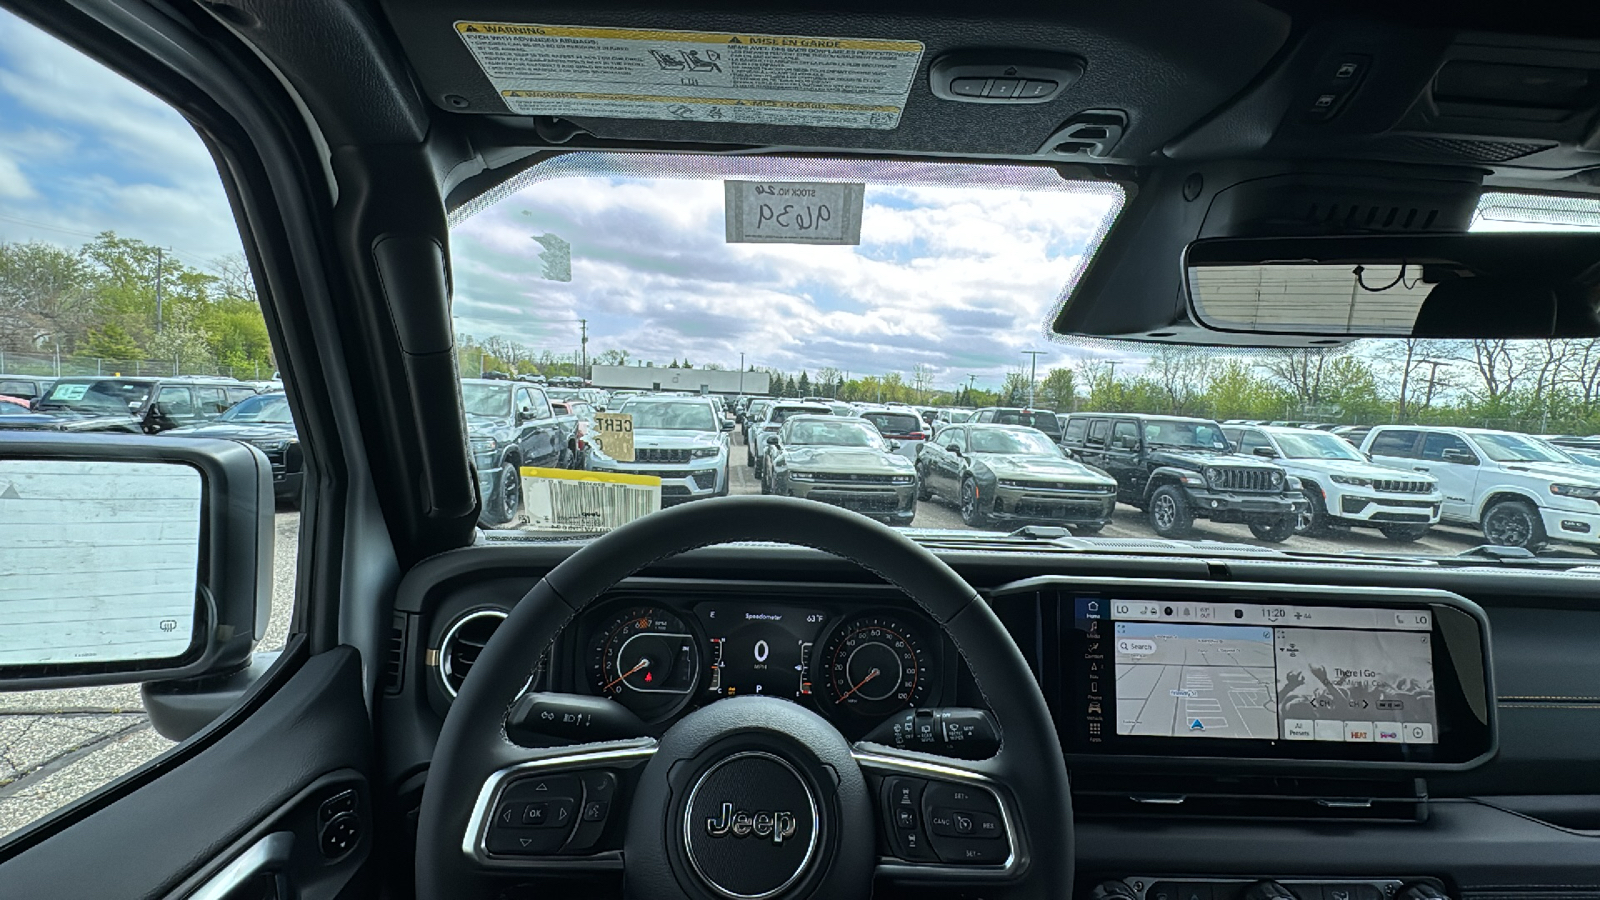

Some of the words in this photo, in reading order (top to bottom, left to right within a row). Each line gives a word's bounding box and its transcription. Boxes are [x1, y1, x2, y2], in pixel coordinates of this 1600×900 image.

[483, 25, 546, 34] WARNING
[801, 40, 840, 48] GARDE
[1116, 606, 1128, 614] LO
[1261, 609, 1285, 618] 11:20
[1415, 616, 1427, 624] LO
[754, 640, 769, 662] 0
[1334, 668, 1358, 677] There
[756, 685, 762, 693] P
[530, 810, 541, 818] OK
[706, 802, 796, 842] Jeep
[934, 817, 950, 826] CANC
